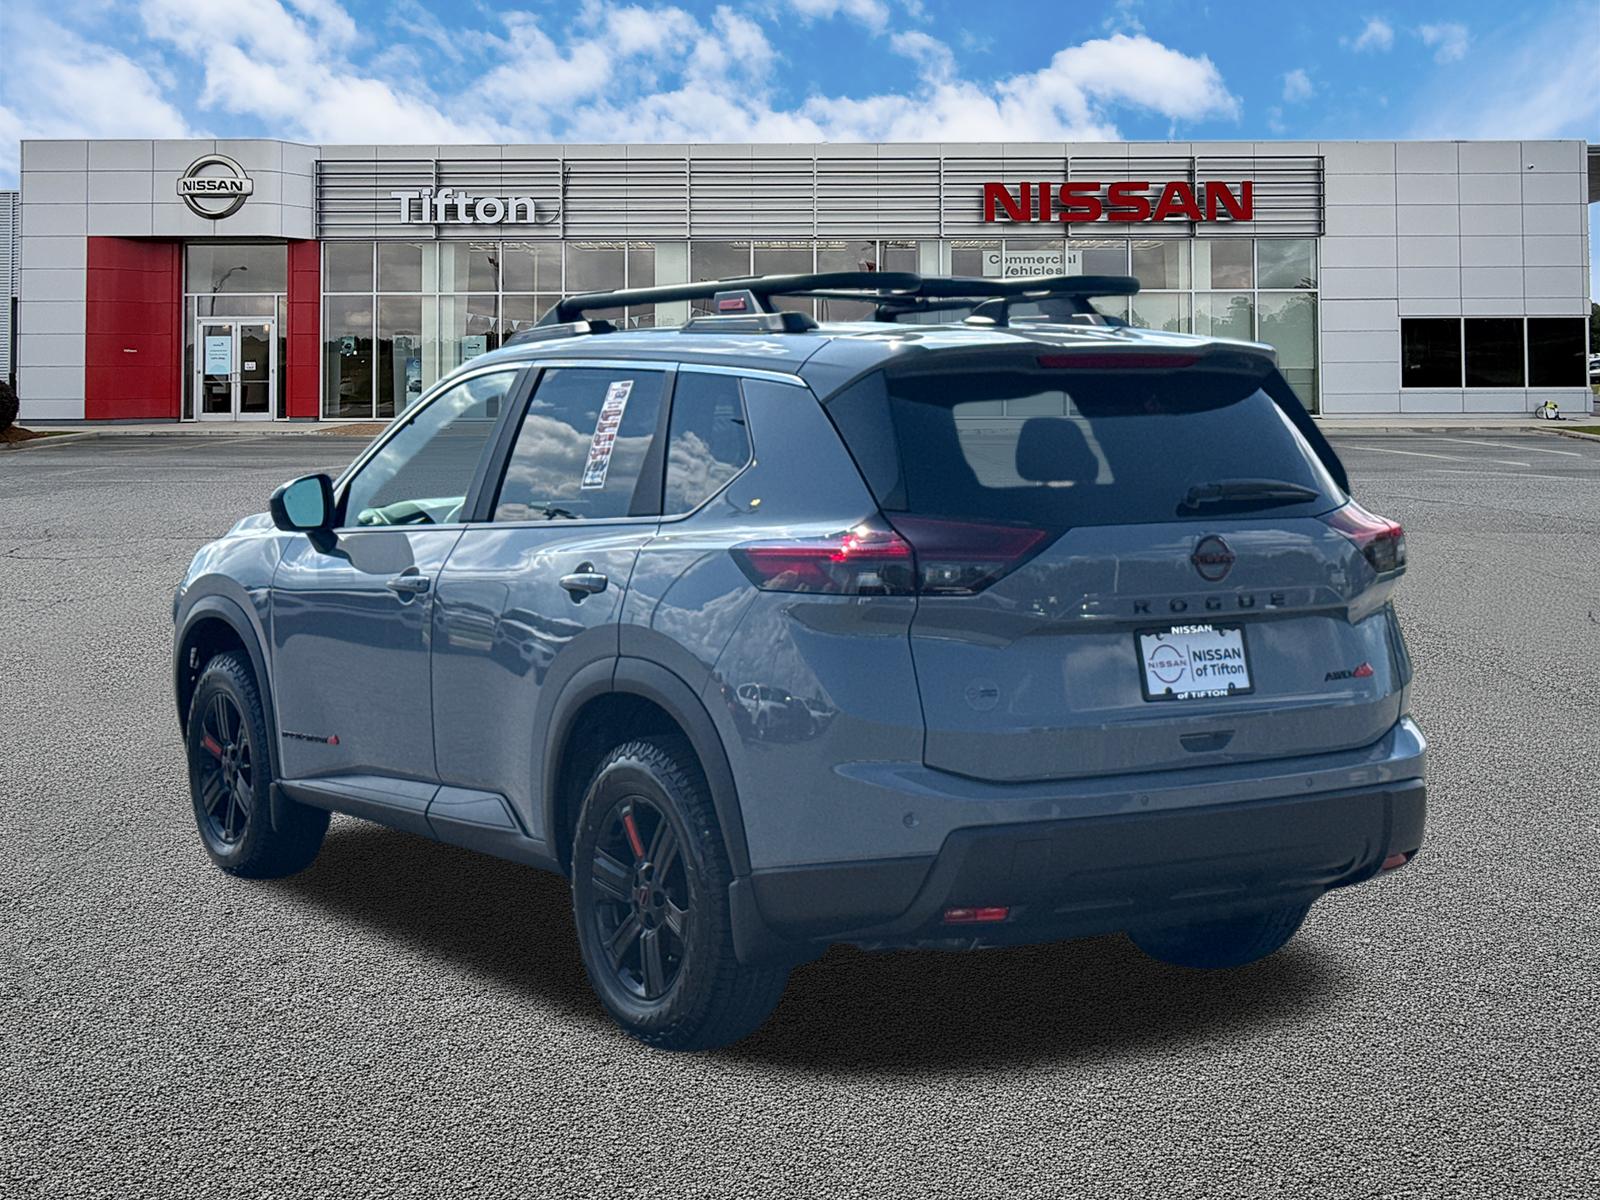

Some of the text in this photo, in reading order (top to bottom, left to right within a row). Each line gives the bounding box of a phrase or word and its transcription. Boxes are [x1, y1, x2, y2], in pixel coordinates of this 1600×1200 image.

[182, 180, 243, 192] NISSAN
[390, 188, 536, 224] Tifton
[983, 181, 1253, 222] NISSAN
[1133, 592, 1285, 615] ROGUE
[1171, 624, 1213, 635] NISSAN
[1192, 647, 1242, 663] NISSAN
[1147, 660, 1187, 669] NISSAN
[1195, 662, 1244, 677] of Tifton
[1177, 691, 1190, 700] of
